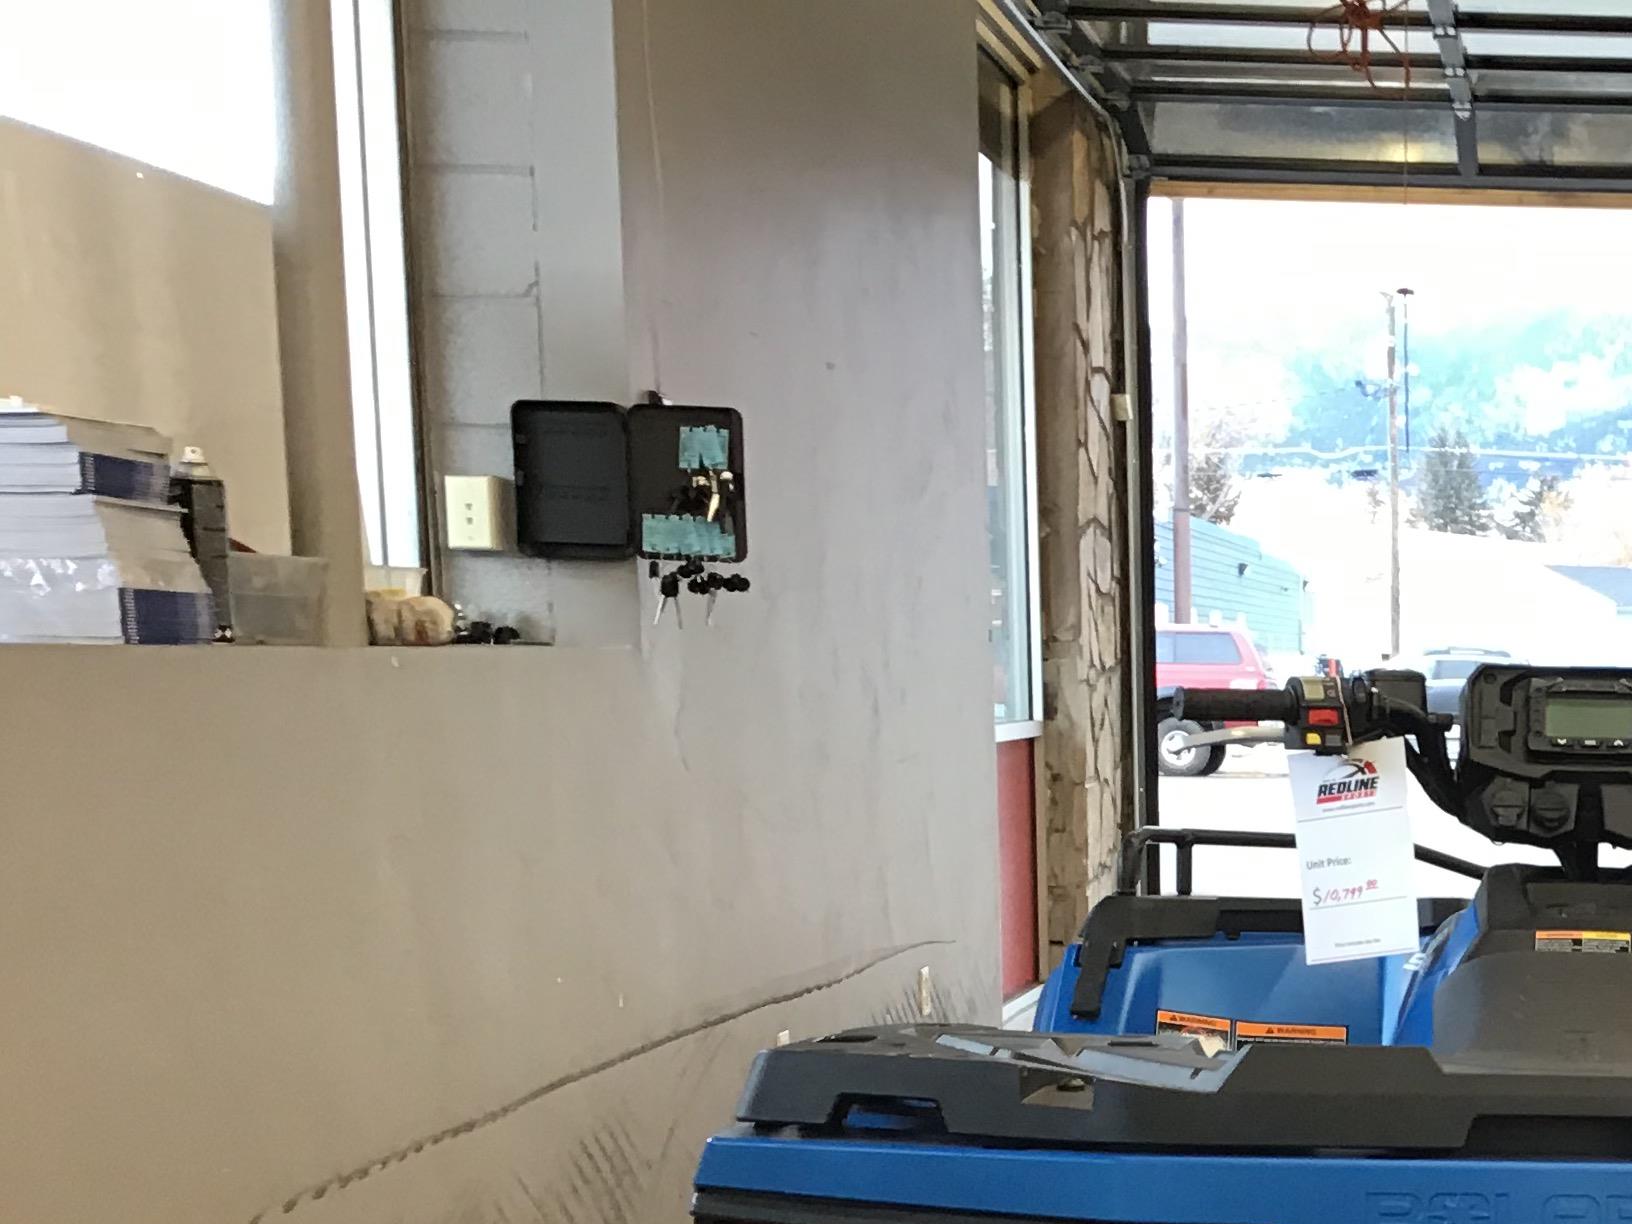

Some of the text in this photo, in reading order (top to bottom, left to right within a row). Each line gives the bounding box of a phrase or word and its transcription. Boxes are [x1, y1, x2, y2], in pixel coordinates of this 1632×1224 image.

[1318, 776, 1380, 797] REDLINE
[1306, 857, 1352, 870] Unit Price:
[1277, 1027, 1317, 1036] WARNING
